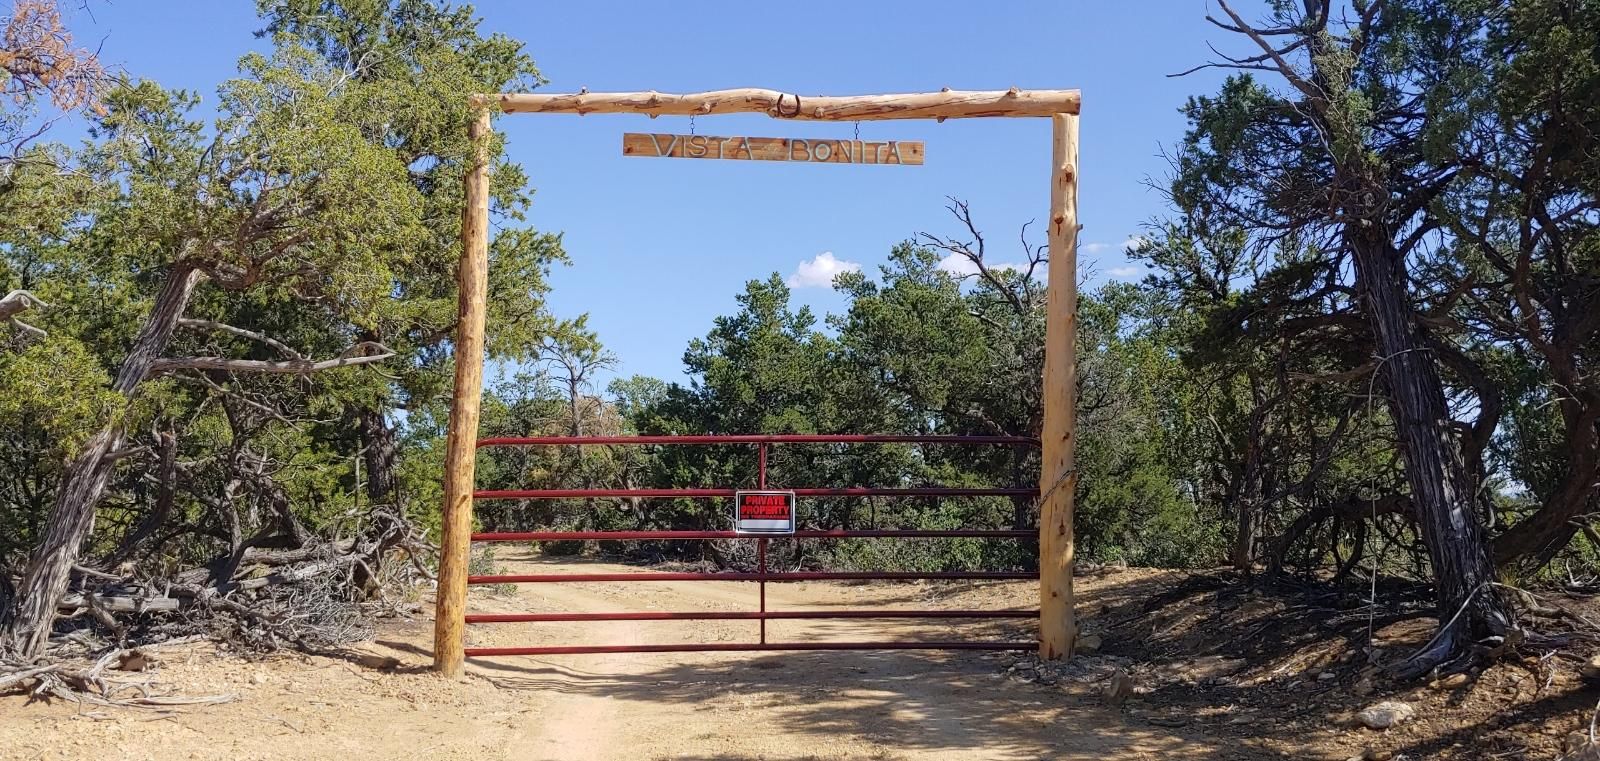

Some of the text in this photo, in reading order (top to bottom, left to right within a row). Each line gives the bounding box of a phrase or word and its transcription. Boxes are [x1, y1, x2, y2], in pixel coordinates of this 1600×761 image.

[650, 134, 904, 165] VISTA BONITA
[745, 495, 785, 505] PRIVATE
[741, 505, 790, 515] PROPERTY
